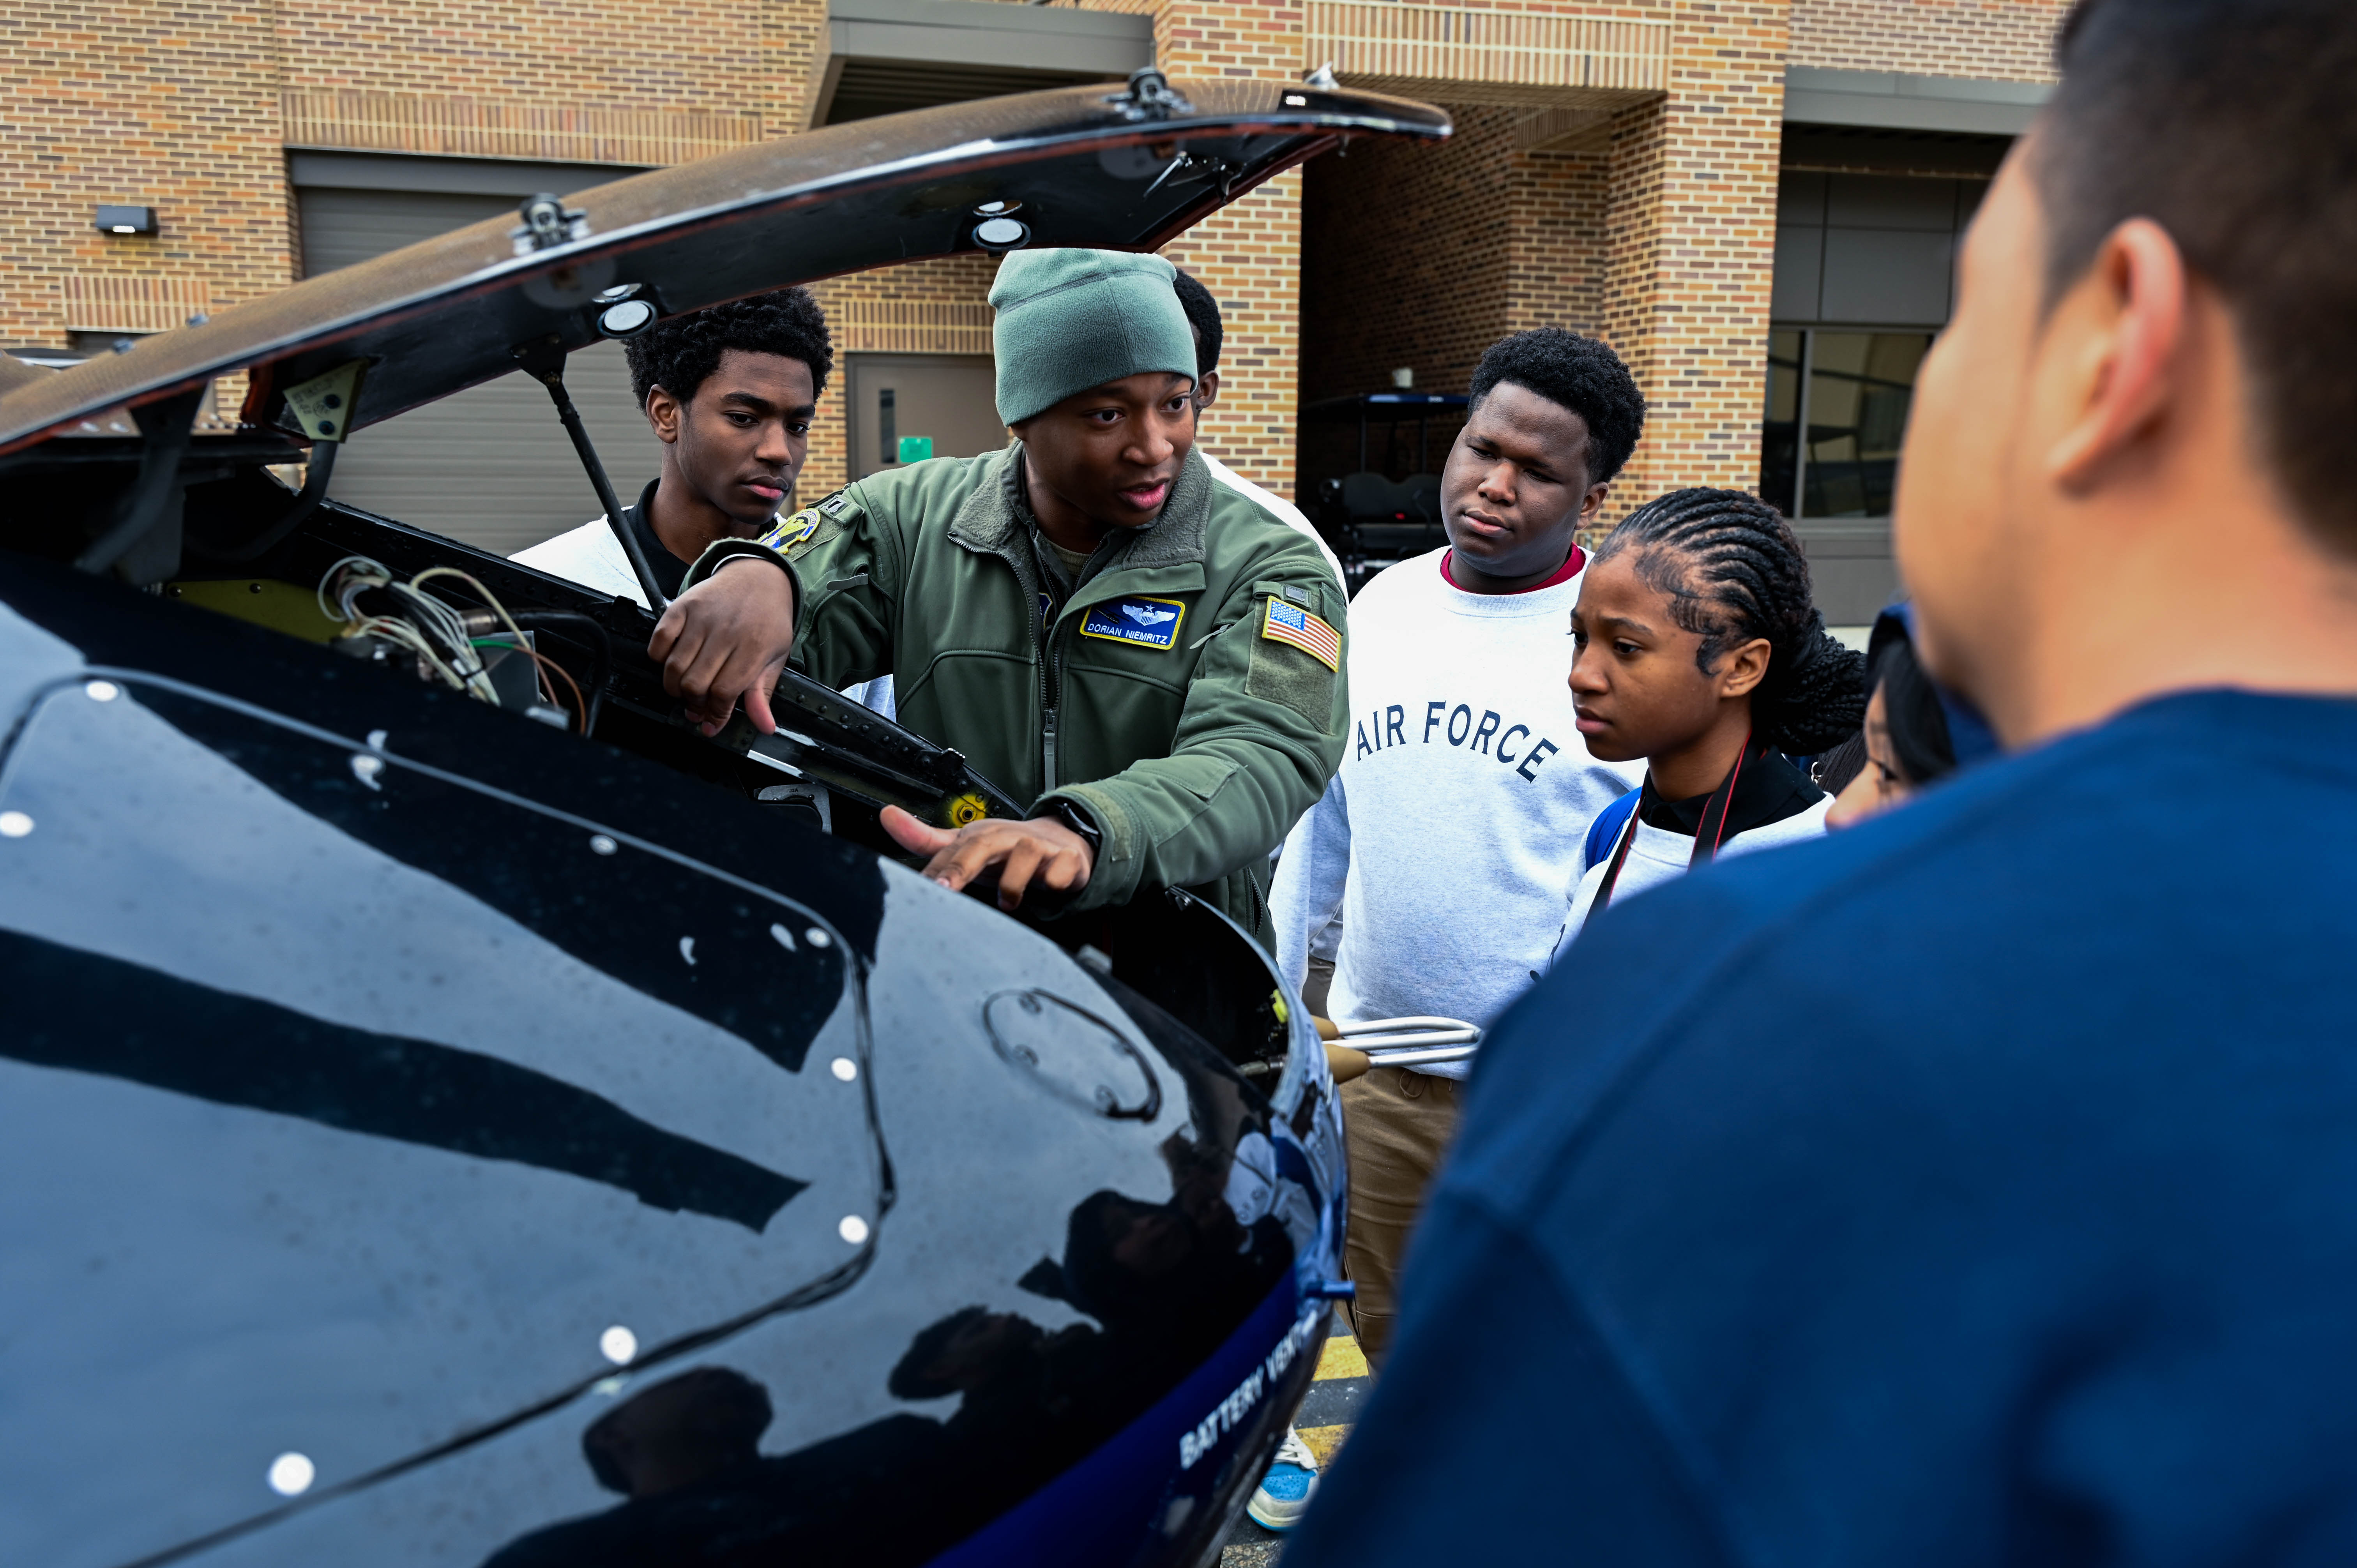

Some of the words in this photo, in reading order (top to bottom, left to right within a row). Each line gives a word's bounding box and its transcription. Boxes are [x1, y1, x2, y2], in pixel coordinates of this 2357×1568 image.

[1088, 623, 1122, 636] DORIAN
[1125, 629, 1168, 645] NIEMRITZ
[1357, 704, 1406, 761] AIR
[1423, 700, 1560, 784] FORCE
[1179, 1364, 1265, 1469] BATTERY
